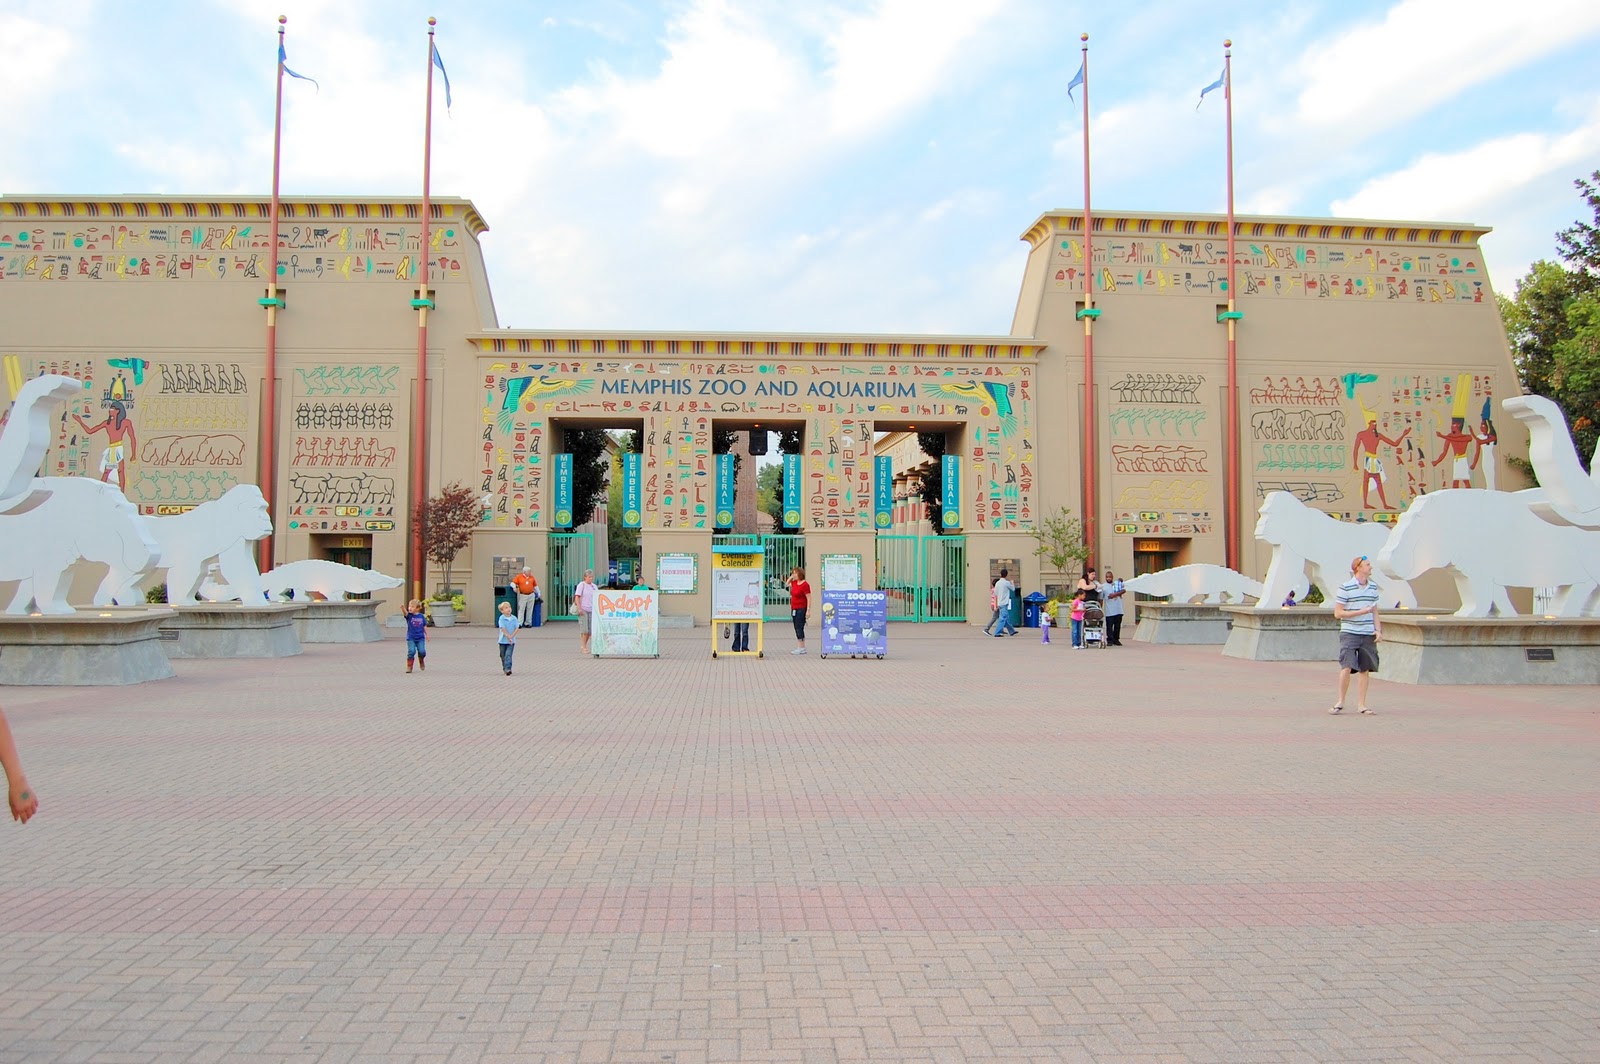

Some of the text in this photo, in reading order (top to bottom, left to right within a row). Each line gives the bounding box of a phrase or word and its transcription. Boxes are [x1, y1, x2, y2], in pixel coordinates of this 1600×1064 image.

[601, 379, 916, 398] MEMPHIS ZOO AND AQUARIUM
[560, 455, 568, 504] MEMBERS
[598, 594, 652, 615] Adopt
